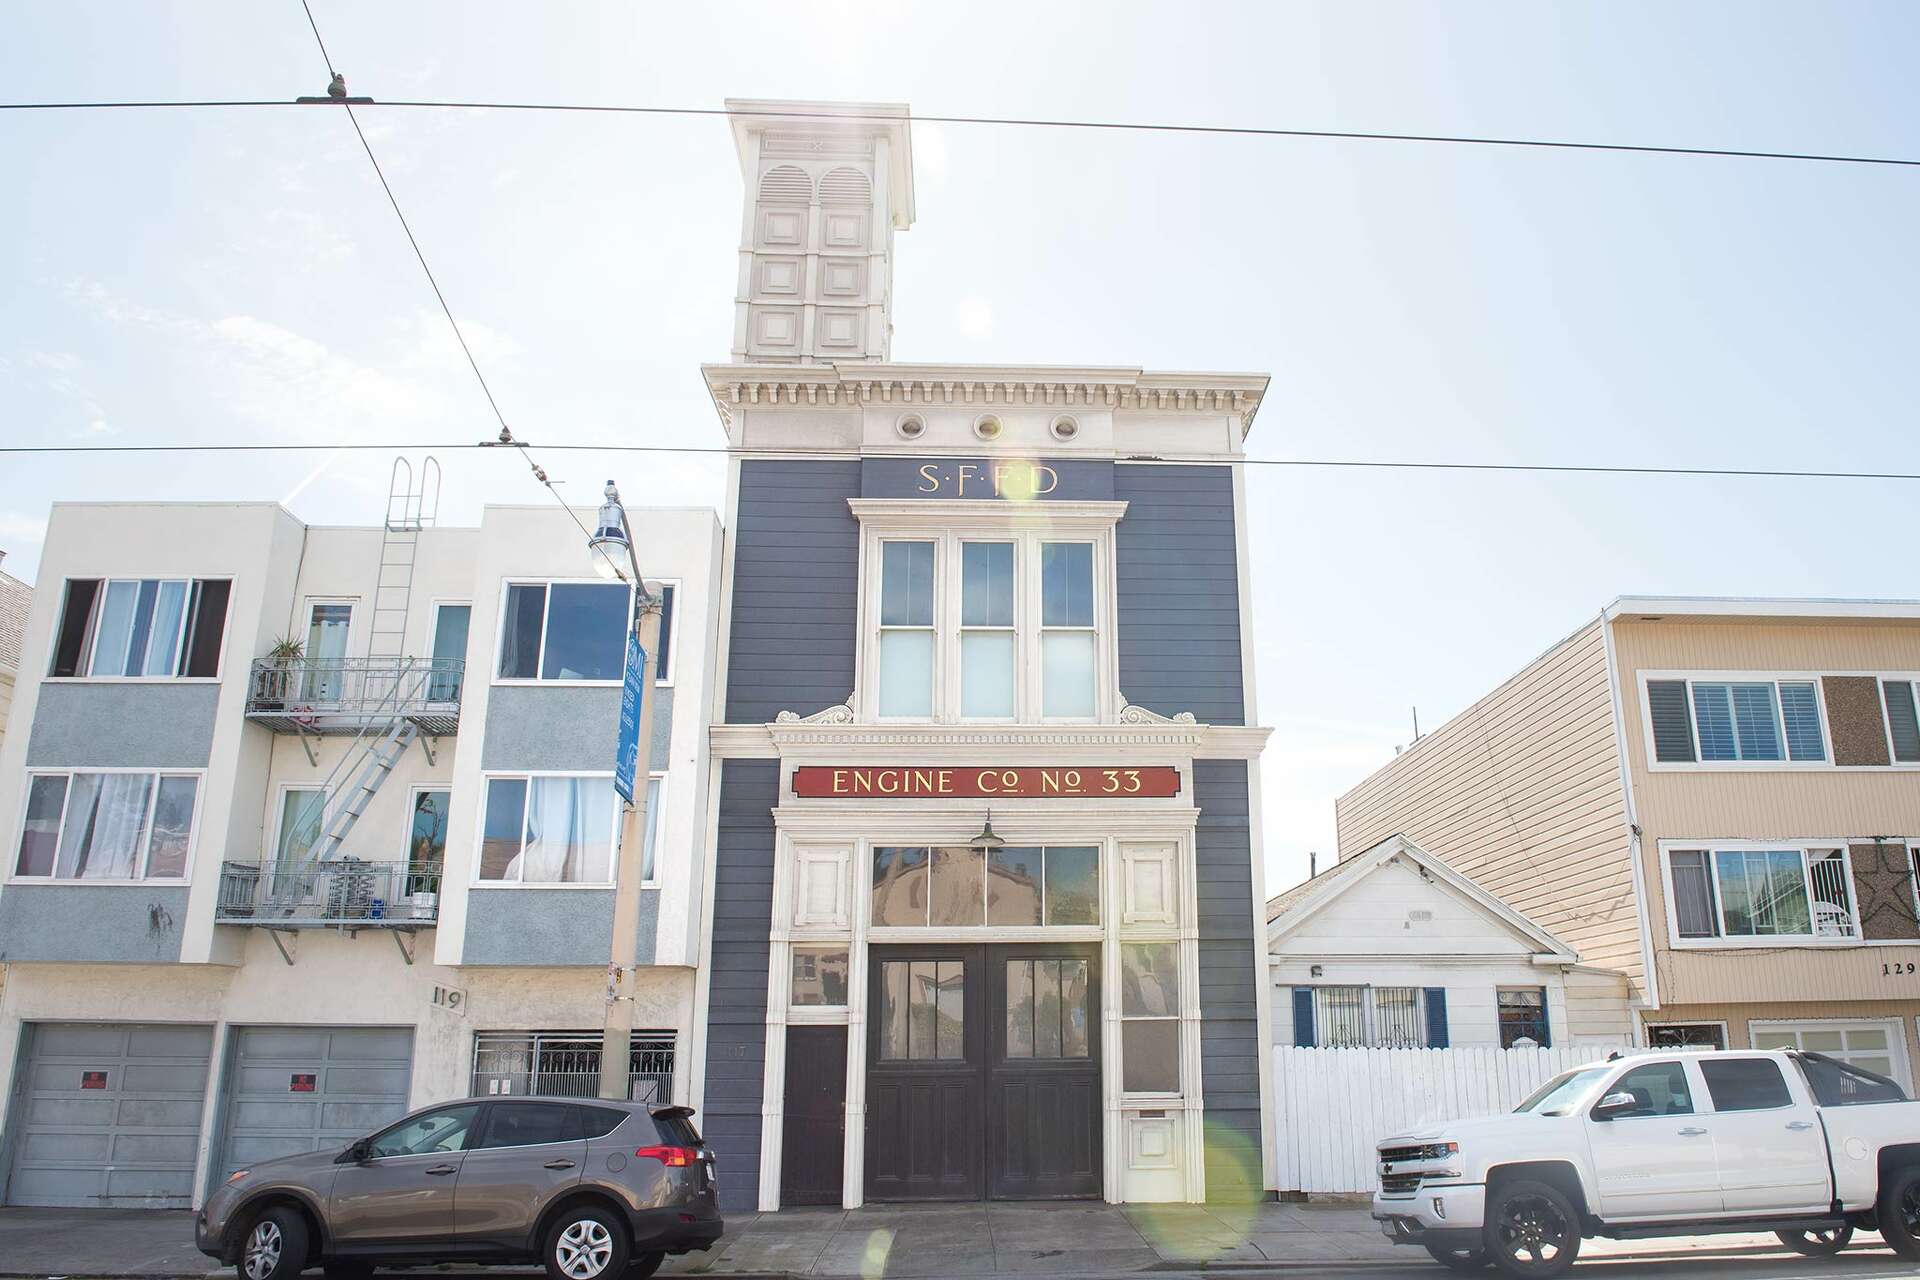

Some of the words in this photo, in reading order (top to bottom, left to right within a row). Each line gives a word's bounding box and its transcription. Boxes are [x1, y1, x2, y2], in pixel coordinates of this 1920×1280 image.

[833, 770, 953, 792] ENGINE
[1102, 770, 1141, 792] 33
[1882, 962, 1916, 976] 129
[433, 986, 461, 1009] 119
